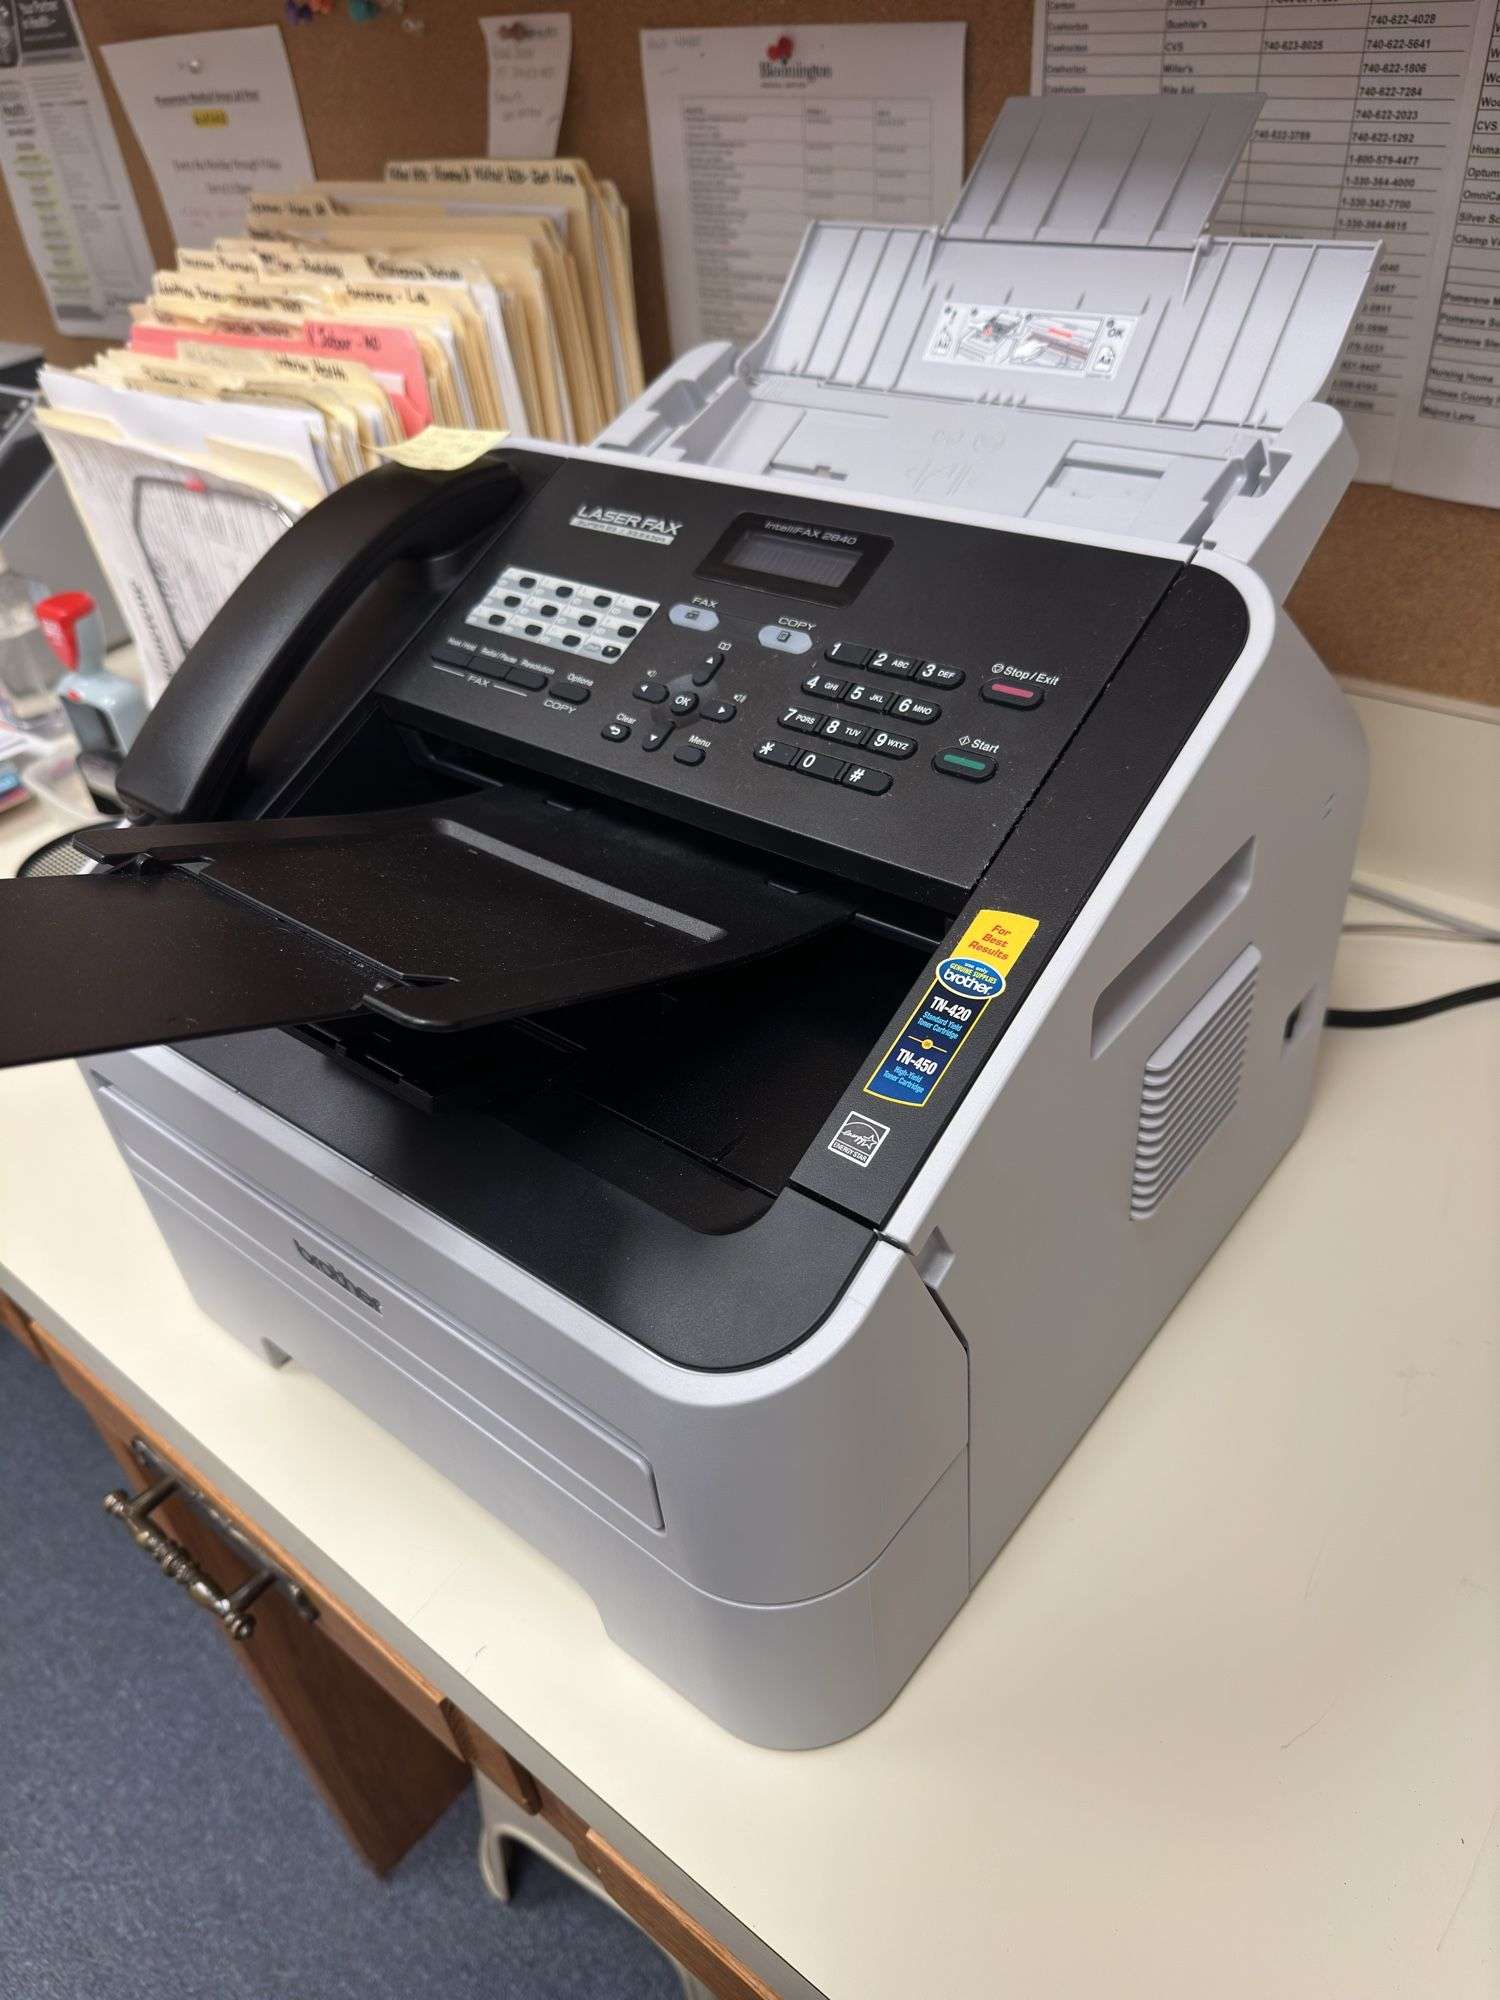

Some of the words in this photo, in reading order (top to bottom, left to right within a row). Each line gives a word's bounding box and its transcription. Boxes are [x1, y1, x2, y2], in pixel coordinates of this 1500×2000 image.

[1477, 121, 1498, 131] CVS
[577, 506, 642, 528] LASER
[641, 518, 684, 536] FAX
[822, 533, 857, 546] 2840
[692, 597, 720, 609] FAX
[777, 616, 818, 632] COPY
[830, 643, 842, 656] 1
[872, 653, 888, 667] 2
[891, 659, 910, 669] ABC
[921, 664, 936, 678] 3
[937, 669, 956, 679] DEF
[467, 675, 491, 688] FAX
[567, 673, 594, 687] Options
[805, 675, 818, 689] 4
[823, 682, 839, 692] GHI
[674, 695, 691, 706] OK
[850, 687, 863, 701] 5
[869, 693, 884, 704] JKL
[544, 699, 577, 714] COPY
[898, 698, 910, 713] 6
[912, 705, 932, 715] MNO
[616, 712, 637, 725] Clear
[783, 708, 798, 721] 7
[826, 720, 840, 734] 8
[845, 727, 862, 737] TUV
[688, 734, 711, 748] Menu
[873, 733, 888, 747] 9
[971, 739, 999, 754] Start
[802, 754, 817, 768] 0
[849, 768, 865, 783] #
[991, 925, 1012, 937] For
[982, 933, 1008, 948] Best
[968, 940, 1009, 961] Results
[944, 968, 993, 995] brother
[949, 963, 973, 976] GENUINE
[973, 970, 997, 985] SUPPLIES
[930, 996, 972, 1022] TN-420
[917, 1018, 933, 1029] Toner
[932, 1024, 959, 1040] Cartridge
[922, 1011, 948, 1027] Standard
[948, 1020, 963, 1032] Yield
[896, 1048, 938, 1075] TN-450
[883, 1070, 899, 1082] Toner
[898, 1077, 924, 1093] Cartridge
[852, 1151, 868, 1161] STAR
[292, 1238, 384, 1315] brother
